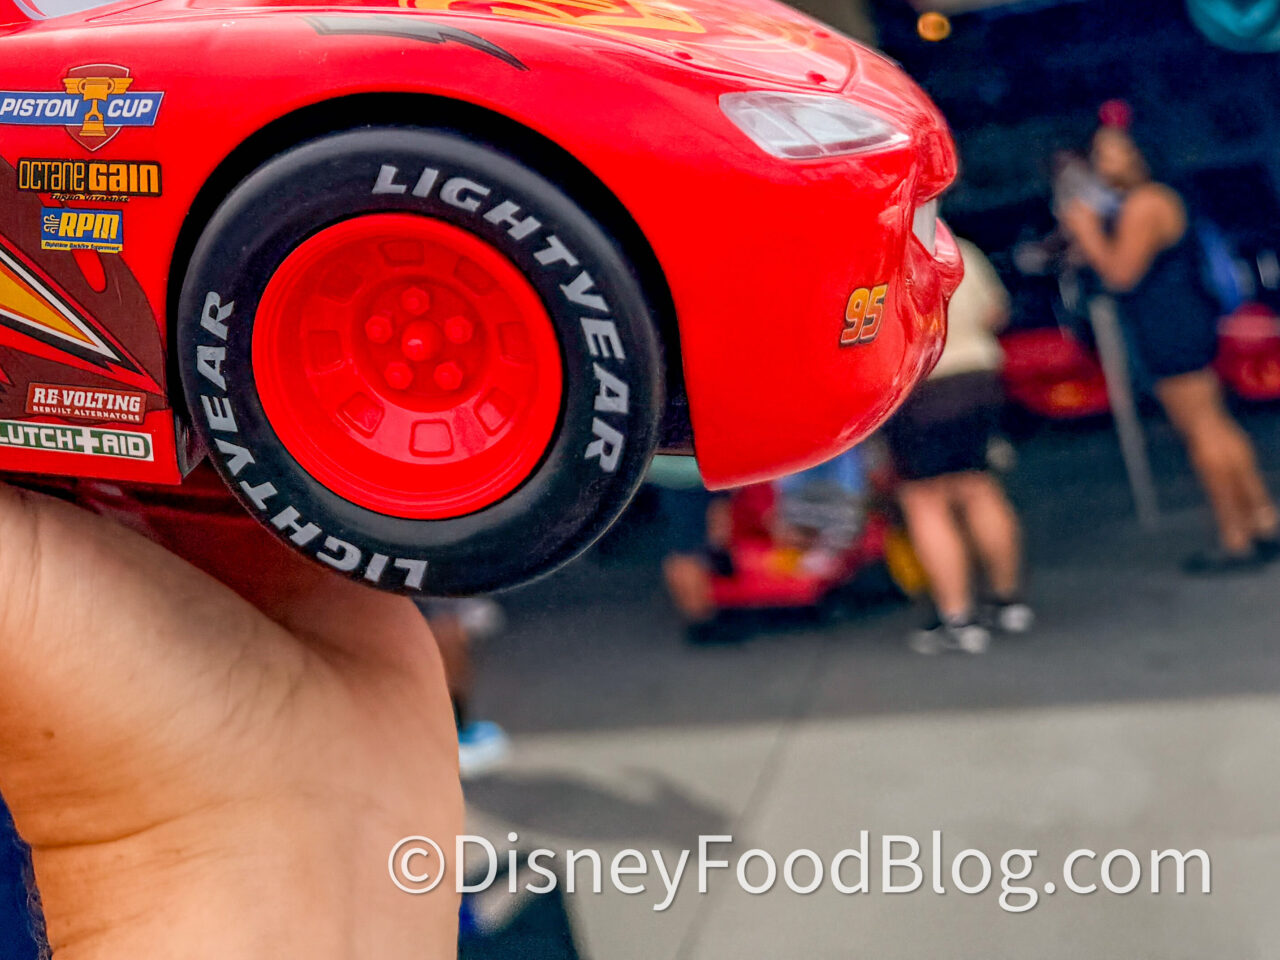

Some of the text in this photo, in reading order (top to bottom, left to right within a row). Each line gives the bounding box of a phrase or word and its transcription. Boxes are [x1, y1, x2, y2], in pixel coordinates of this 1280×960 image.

[0, 97, 154, 118] PISTON CUP
[58, 212, 119, 240] RPM
[371, 164, 630, 473] LIGHTYEAR
[840, 283, 888, 346] 95
[32, 405, 140, 422] REBUILT ALTERNATORS
[196, 291, 429, 590] LIGHTYEAR
